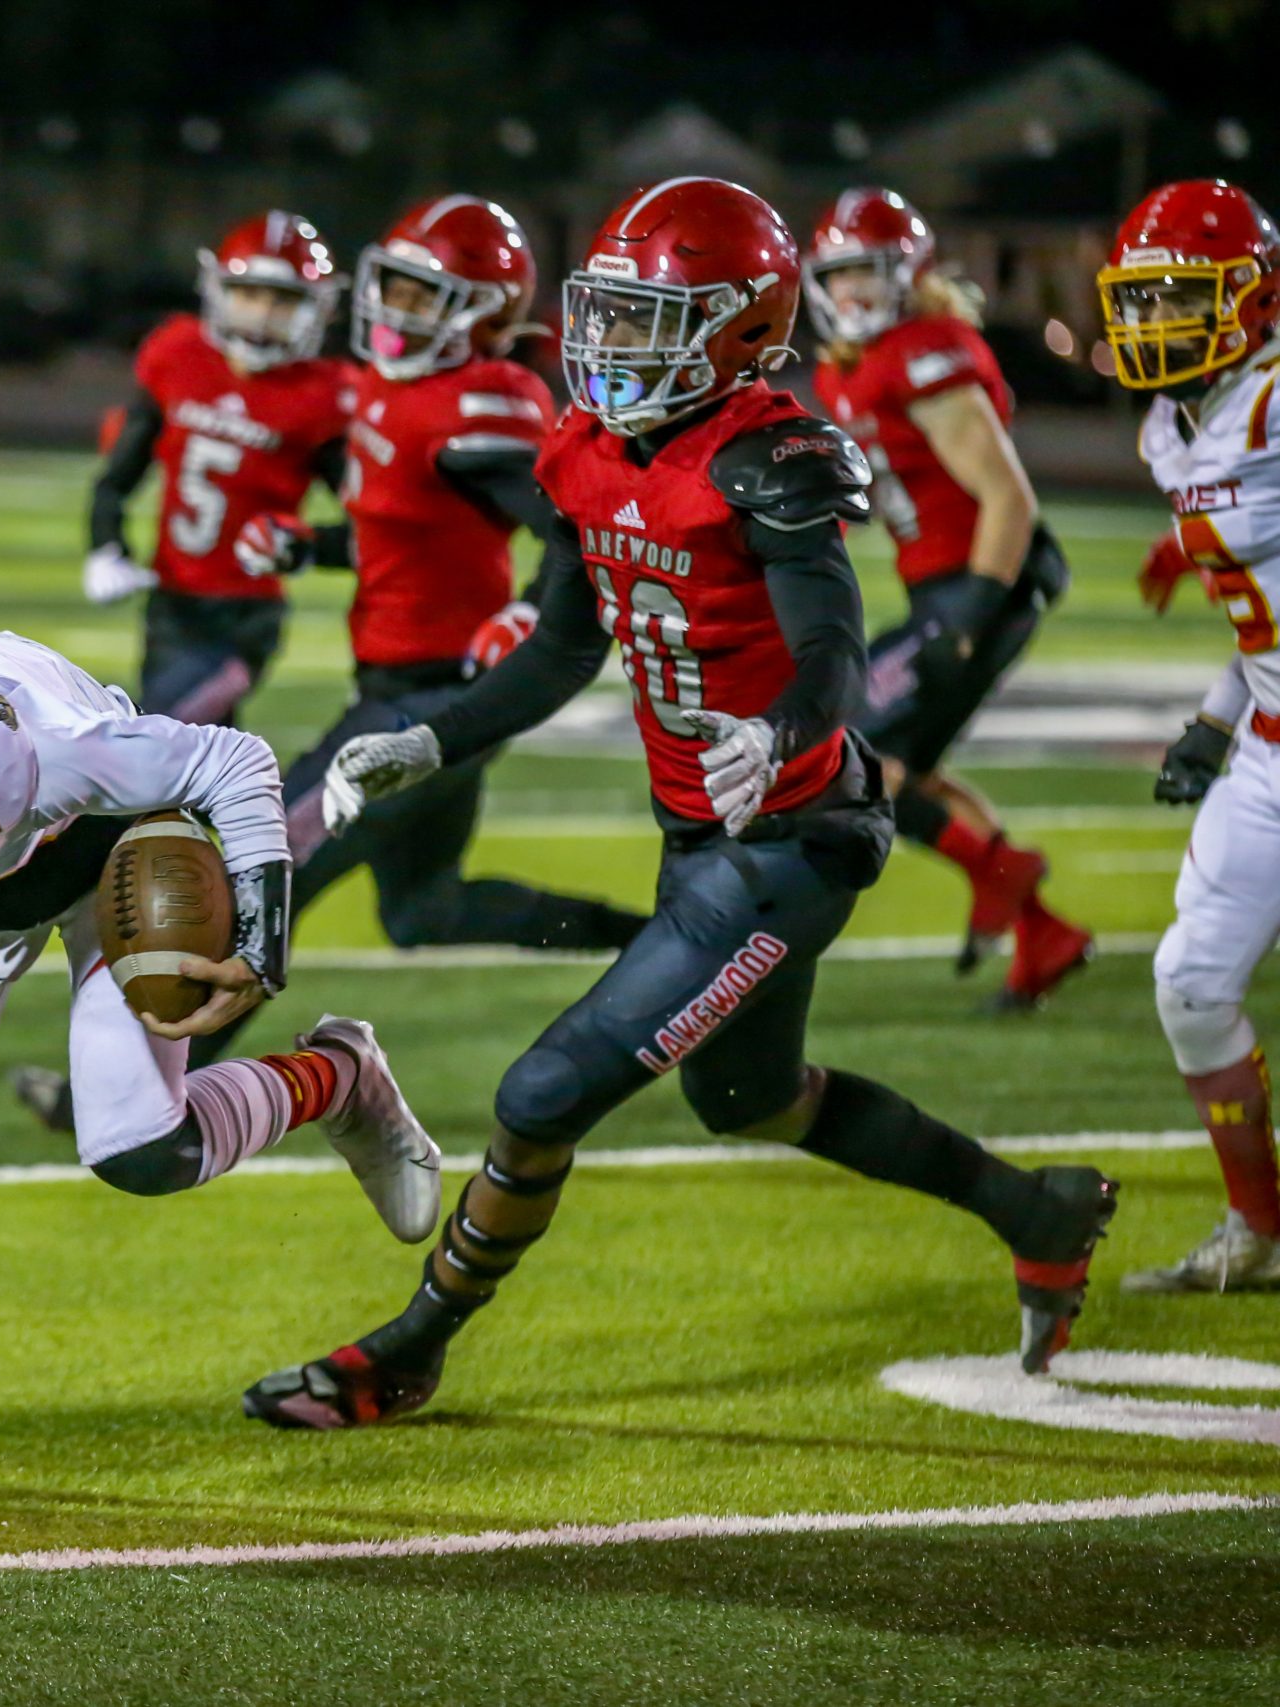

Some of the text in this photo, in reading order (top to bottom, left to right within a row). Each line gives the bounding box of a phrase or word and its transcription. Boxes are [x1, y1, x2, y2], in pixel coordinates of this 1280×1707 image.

[169, 432, 244, 557] 5
[585, 527, 692, 577] AKEWOOD
[635, 931, 788, 1075] LAKEWOOD
